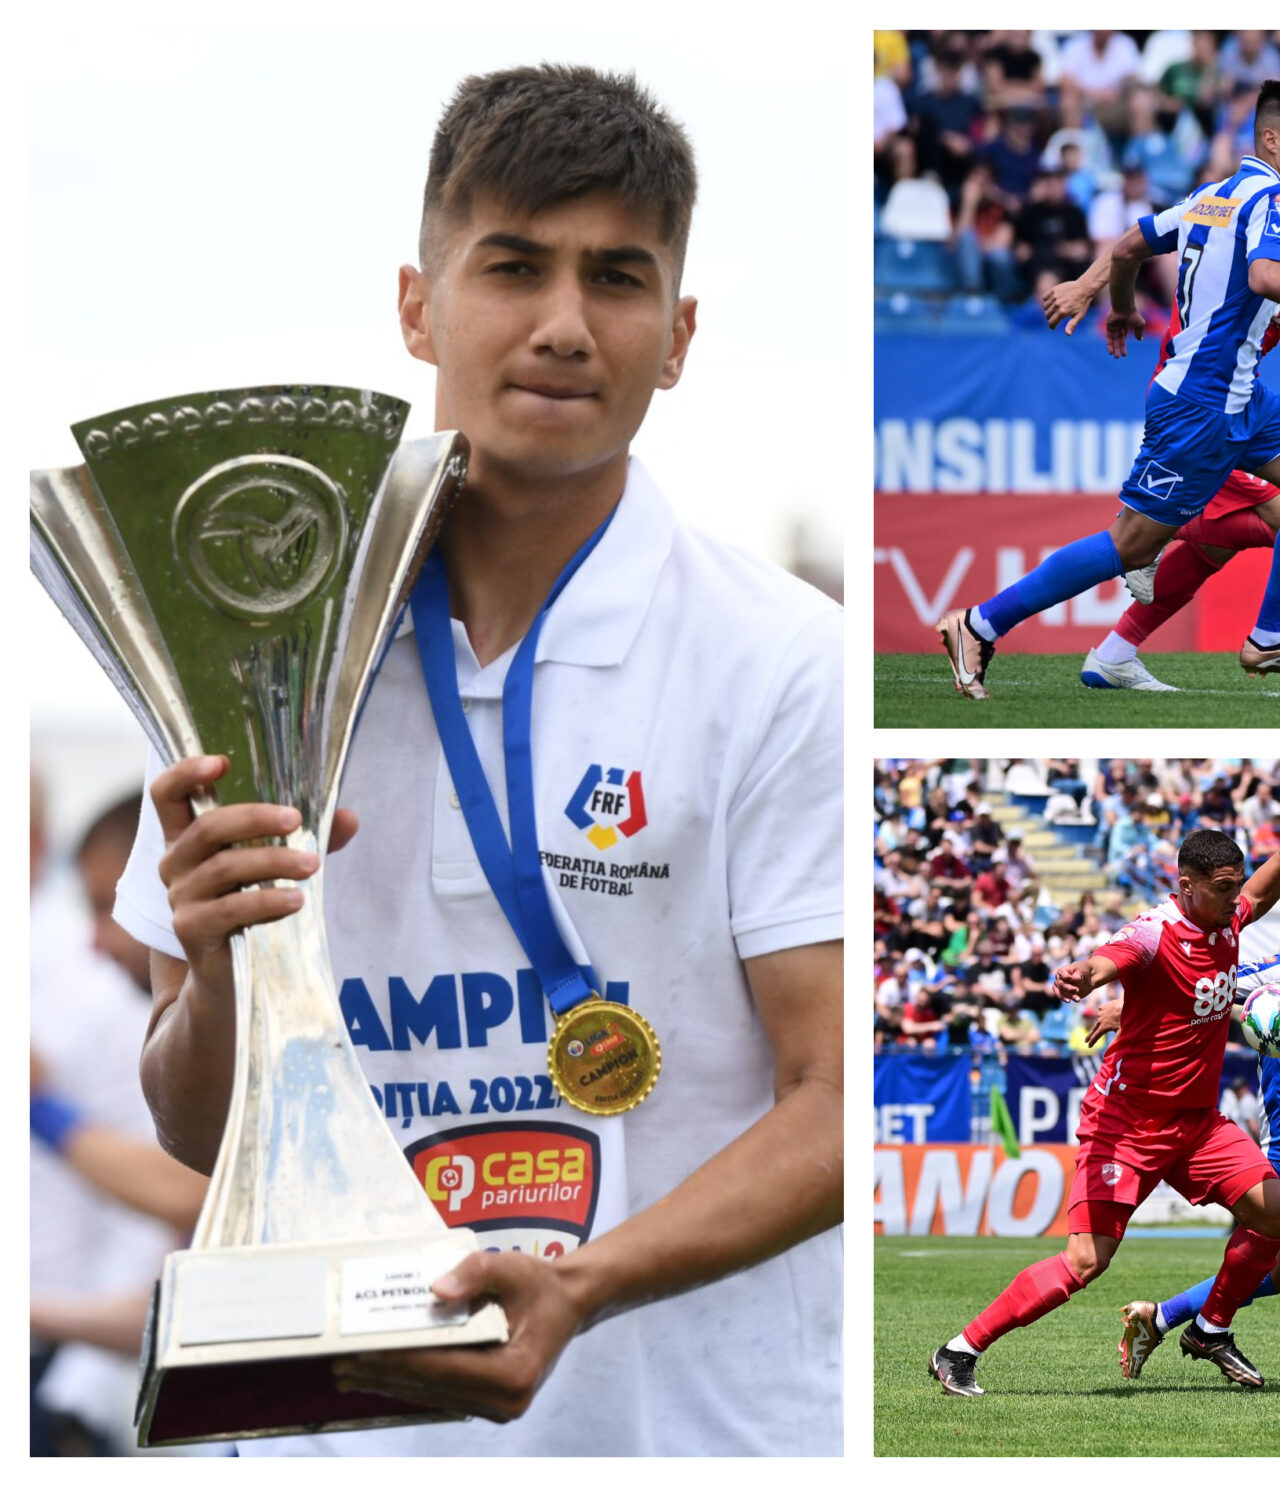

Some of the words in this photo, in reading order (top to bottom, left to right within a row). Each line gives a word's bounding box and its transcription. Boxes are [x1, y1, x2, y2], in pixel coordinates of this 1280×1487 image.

[590, 789, 626, 816] FRF
[559, 873, 579, 889] DE
[581, 875, 634, 897] FOTBAL
[1193, 963, 1237, 1018] 888
[579, 1047, 639, 1087] CAMPION
[481, 1147, 586, 1186] casa
[481, 1183, 583, 1210] pariurilor
